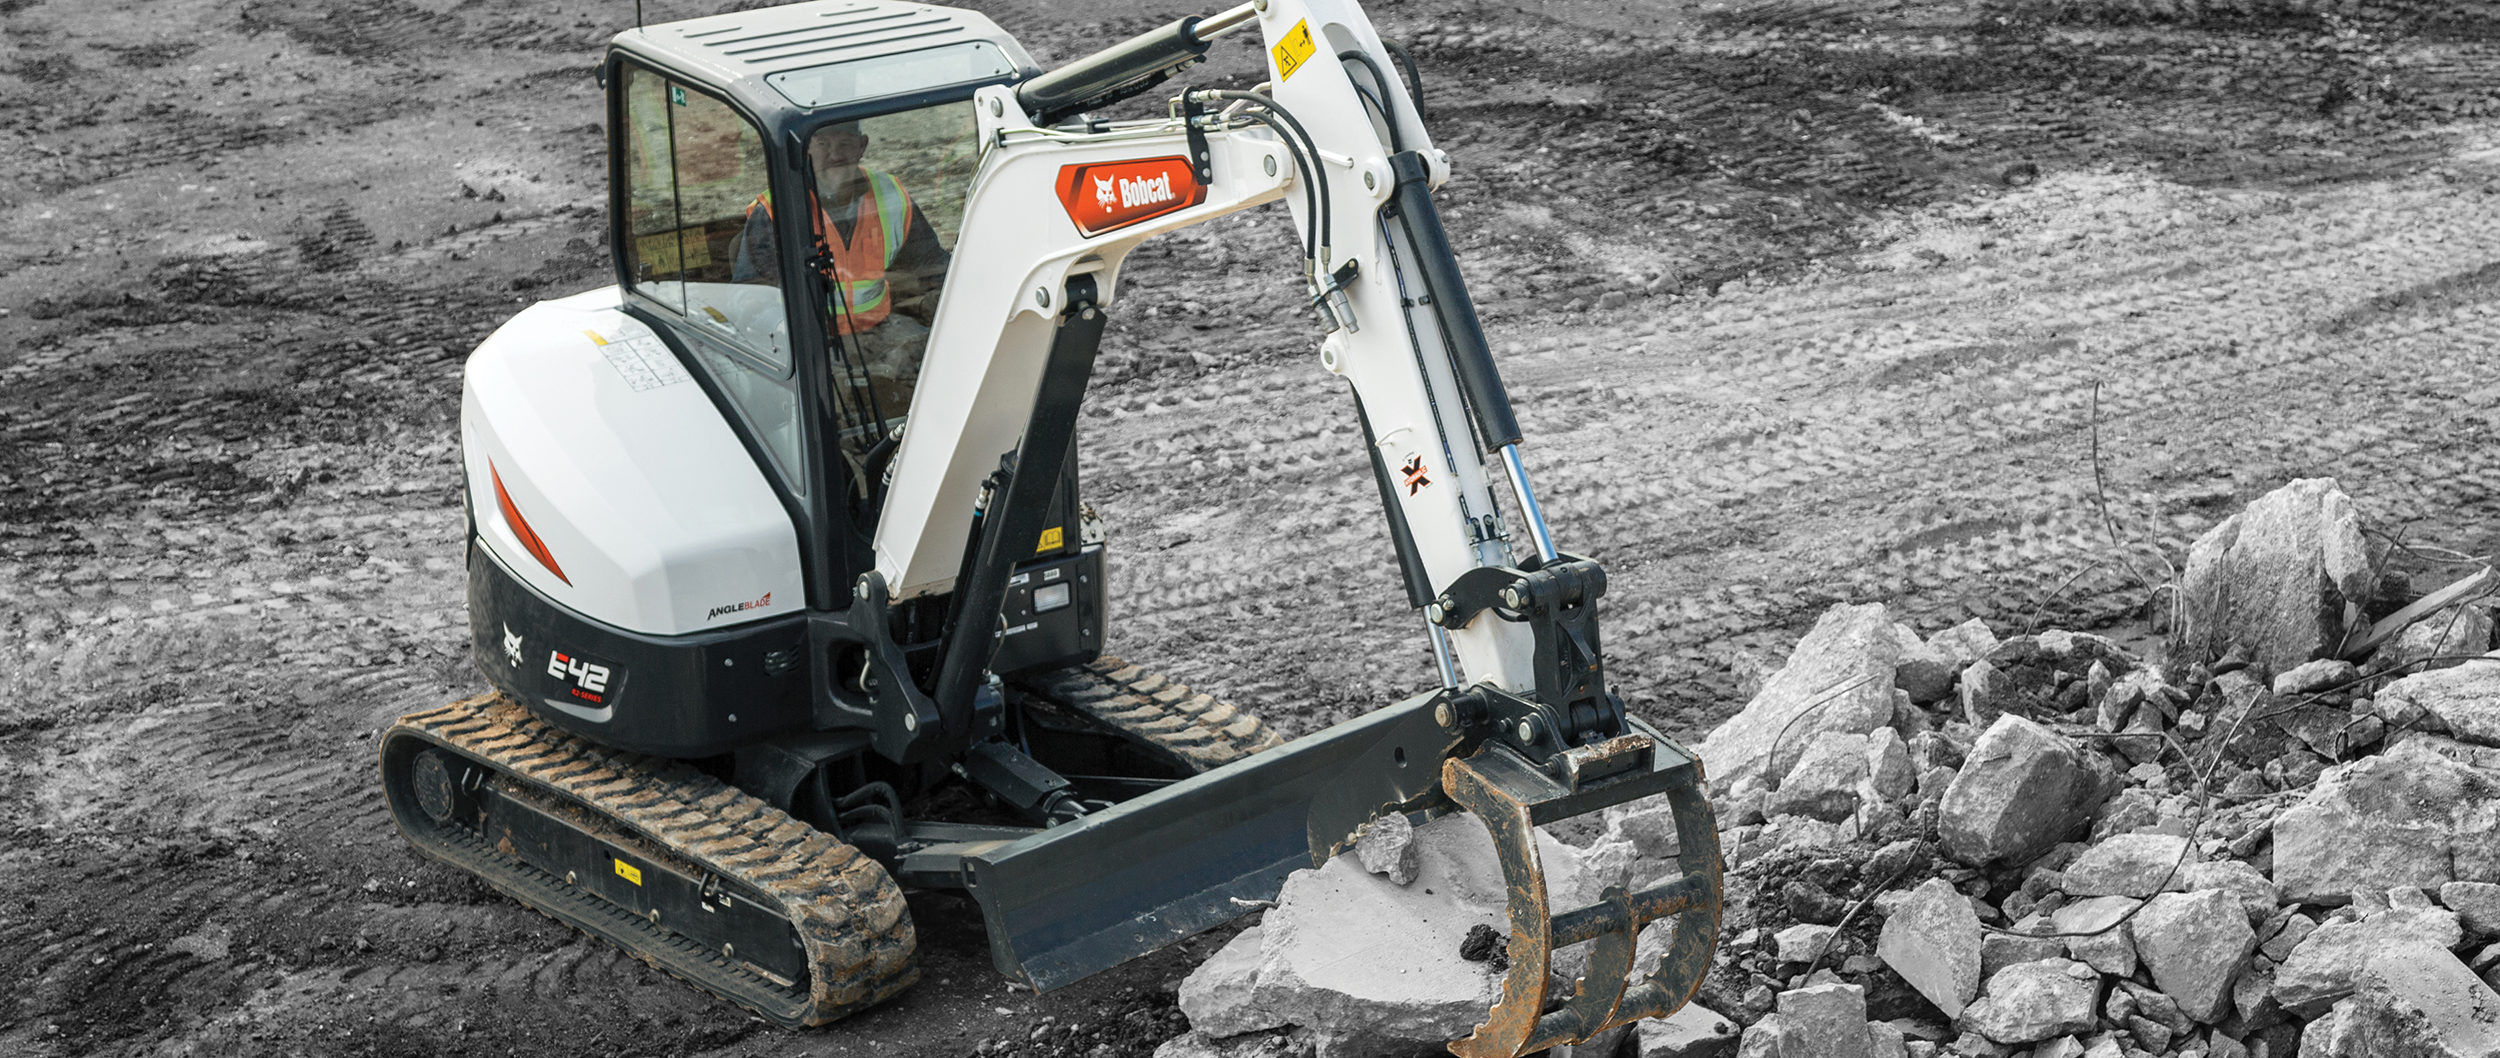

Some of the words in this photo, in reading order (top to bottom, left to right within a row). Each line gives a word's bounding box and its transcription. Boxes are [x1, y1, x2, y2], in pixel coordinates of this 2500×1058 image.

[1118, 171, 1174, 208] Bobcat
[707, 598, 770, 621] ANGLEBLADE
[547, 650, 610, 693] E42
